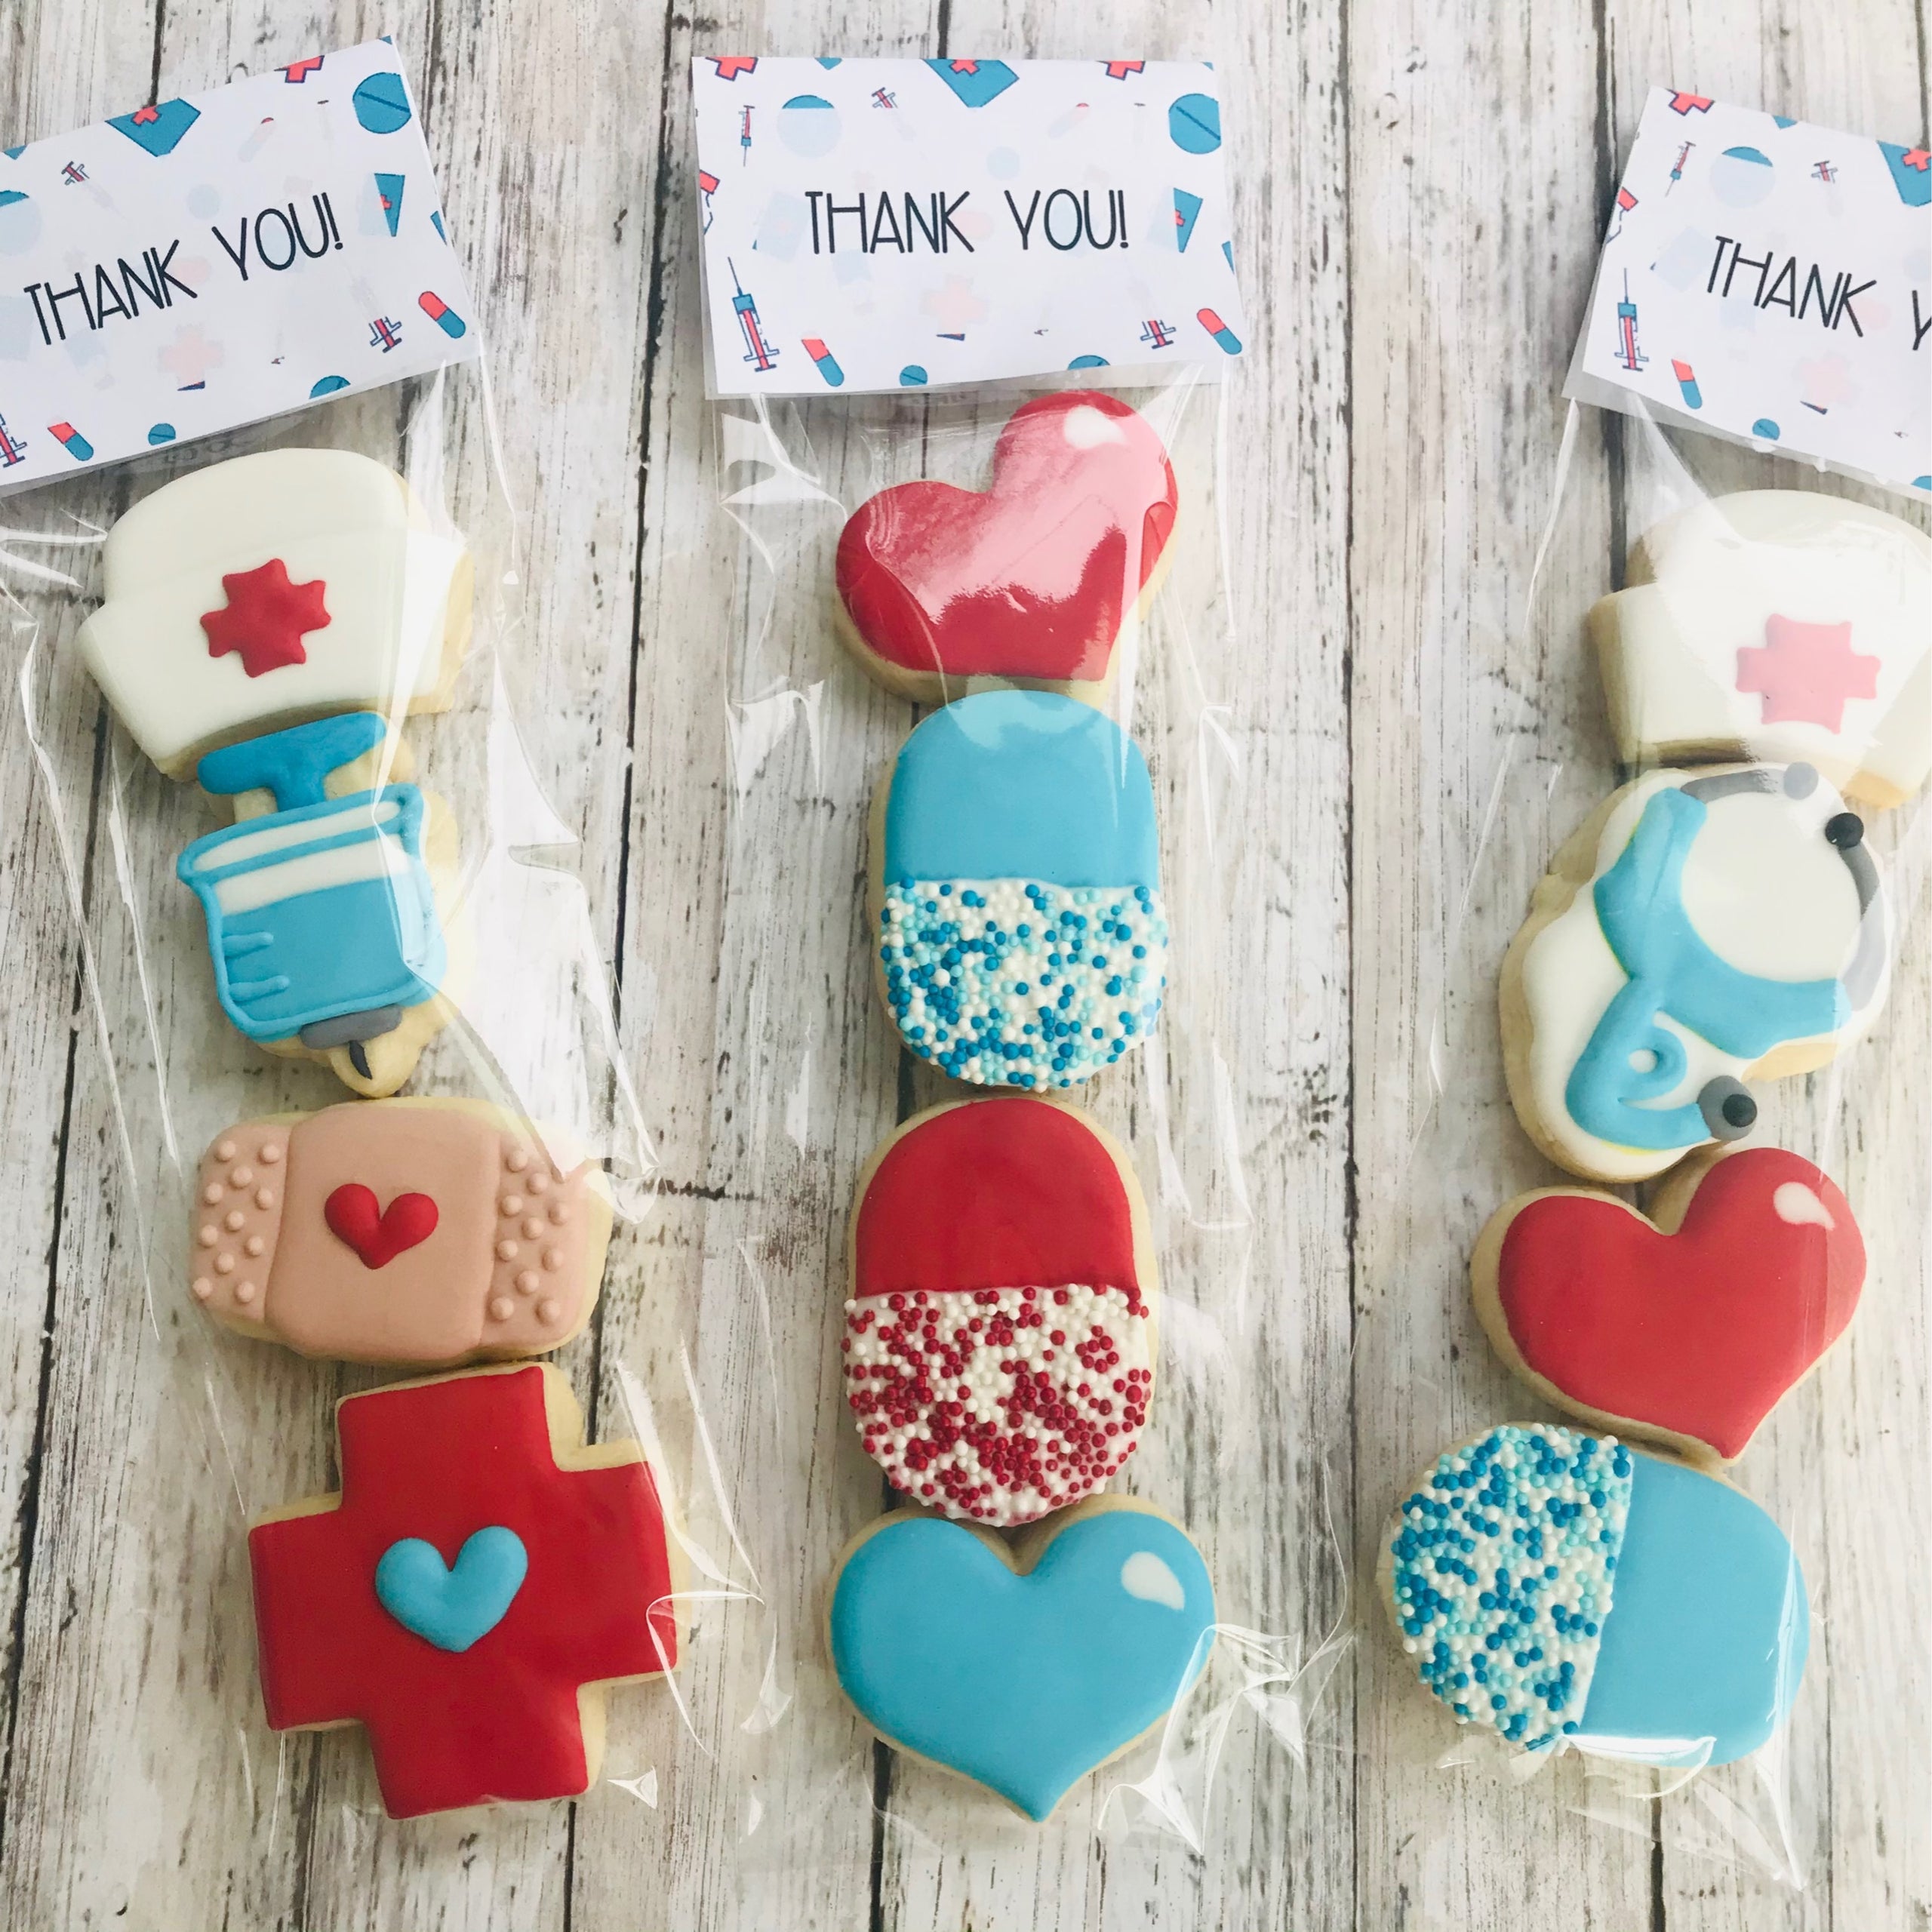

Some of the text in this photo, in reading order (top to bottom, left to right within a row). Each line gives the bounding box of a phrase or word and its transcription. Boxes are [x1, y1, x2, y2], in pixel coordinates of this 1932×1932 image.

[23, 192, 344, 346] THANK YOU!
[804, 189, 1129, 255] THANK YOU!
[1707, 235, 1877, 337] THANK
